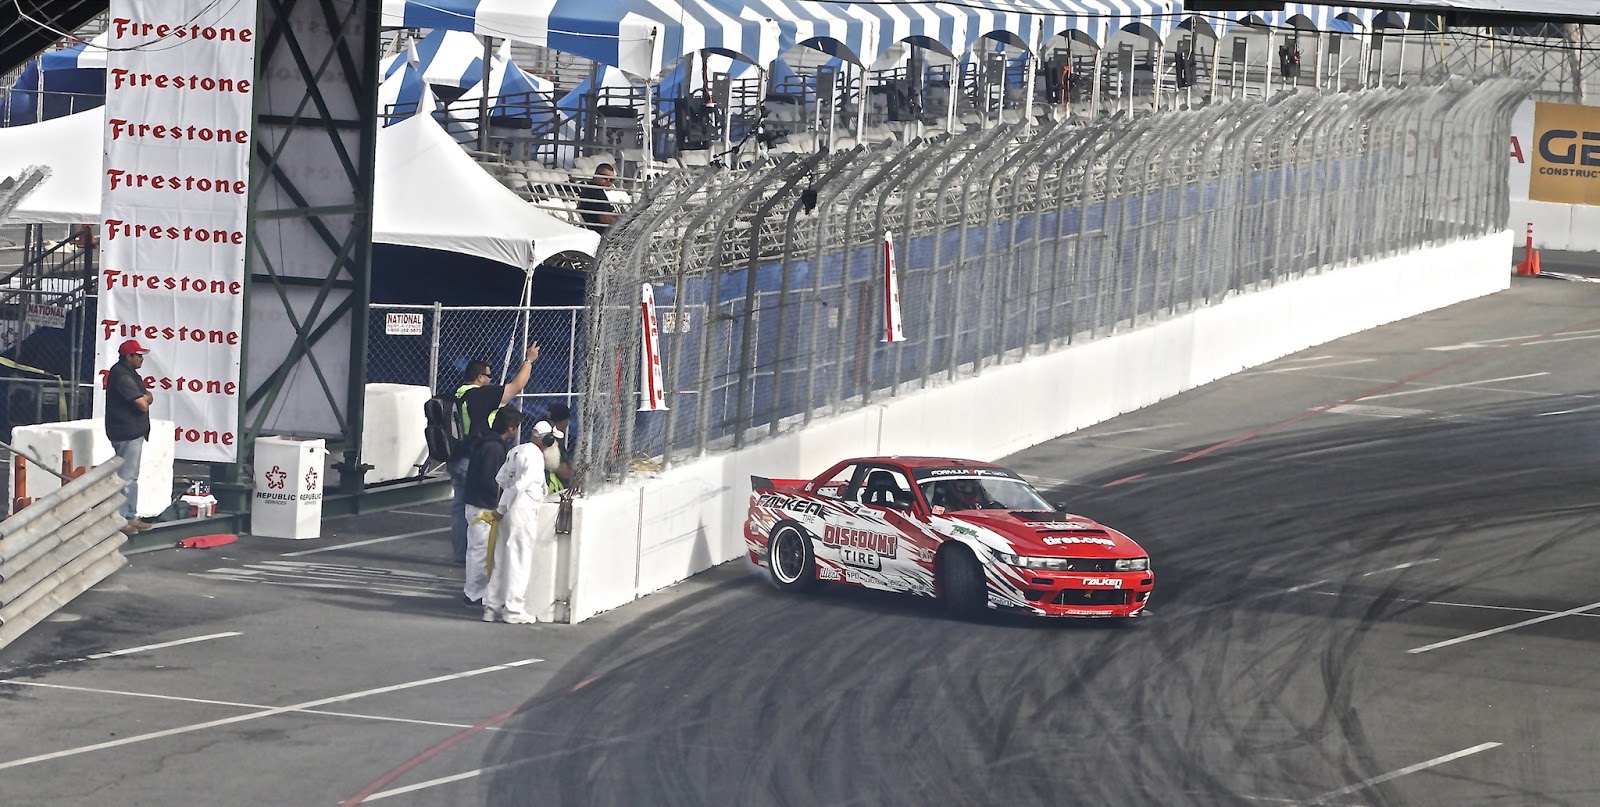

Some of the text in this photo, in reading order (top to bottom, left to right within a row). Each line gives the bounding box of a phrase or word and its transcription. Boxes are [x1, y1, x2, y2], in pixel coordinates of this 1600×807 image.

[113, 18, 253, 42] Firestone
[111, 68, 251, 93] Firestone
[109, 118, 249, 144] Firestone
[107, 168, 247, 194] Firestone
[1539, 167, 1600, 178] CONSTRUC
[105, 219, 244, 245] Firestone
[103, 269, 242, 295] Firestone
[28, 303, 65, 318] NATIONAL
[387, 314, 421, 324] NATIONAL
[101, 319, 239, 345] Firestone
[98, 369, 237, 396] Festone
[256, 491, 296, 501] REPUBLIC
[757, 494, 827, 518] FALKEN
[802, 514, 816, 524] TIRE
[823, 524, 897, 557] DISCOUNT
[1043, 536, 1116, 547] tires.com
[844, 550, 875, 566] TIRE
[1082, 578, 1123, 589] FALKEN
